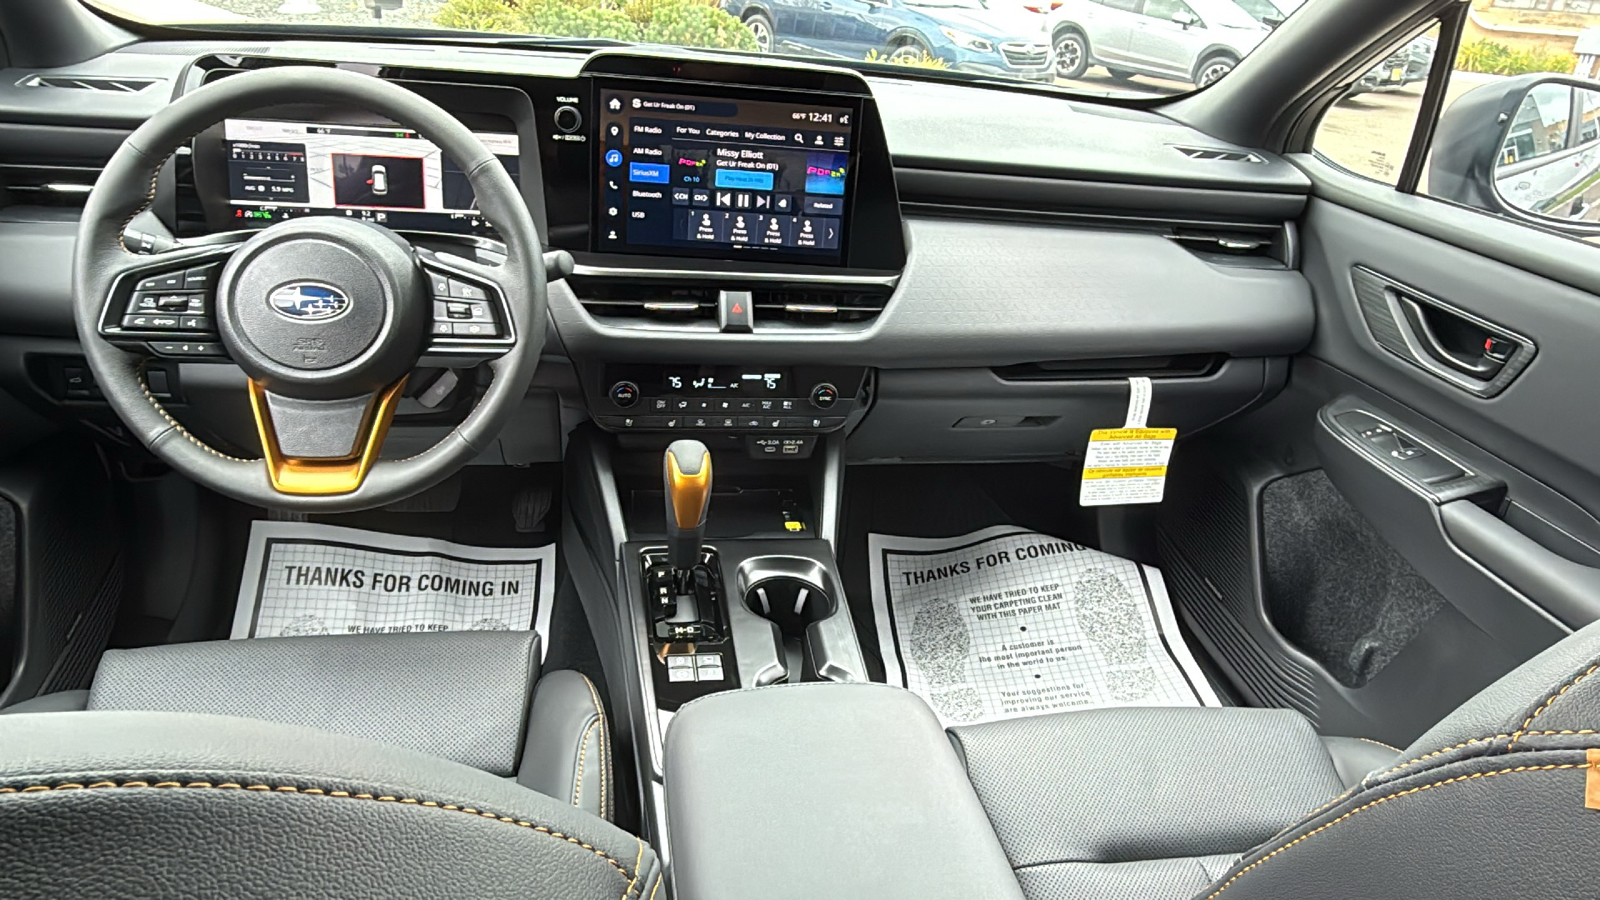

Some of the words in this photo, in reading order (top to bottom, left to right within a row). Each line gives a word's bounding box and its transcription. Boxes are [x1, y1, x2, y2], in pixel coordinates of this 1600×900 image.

[808, 112, 832, 122] 12:41
[706, 128, 739, 138] Categories
[756, 132, 785, 141] Collection
[717, 148, 739, 158] Missy
[741, 150, 764, 159] Elliott
[766, 162, 778, 171] (01)
[632, 190, 662, 198] Bluetooth
[377, 213, 385, 221] P
[668, 377, 682, 388] 75
[764, 378, 776, 389] 75
[903, 561, 970, 585] THANKS
[976, 551, 1010, 569] FOR
[1016, 542, 1086, 561] COMING
[285, 565, 366, 589] THANKS
[372, 572, 411, 592] FOR
[418, 574, 494, 597] COMING
[501, 580, 520, 595] IN
[982, 592, 1003, 602] HAVE
[1005, 589, 1026, 598] TRIED
[1041, 584, 1059, 592] KEEP
[970, 604, 992, 613] YOUR
[994, 598, 1037, 609] CARPETING
[1038, 593, 1062, 602] CLEAN
[977, 612, 997, 620] WITH
[999, 609, 1016, 617] THIS
[1018, 606, 1042, 615] PAPER
[1045, 602, 1061, 611] MAT
[348, 625, 360, 633] WE
[388, 625, 412, 633] TRIED
[428, 624, 448, 632] KEEP
[1010, 640, 1044, 650] customer
[1015, 646, 1053, 658] important
[1055, 645, 1082, 654] person
[1022, 657, 1044, 666] world
[1022, 684, 1070, 695] suggestions
[1001, 696, 1042, 707] improving
[1060, 691, 1090, 699] service
